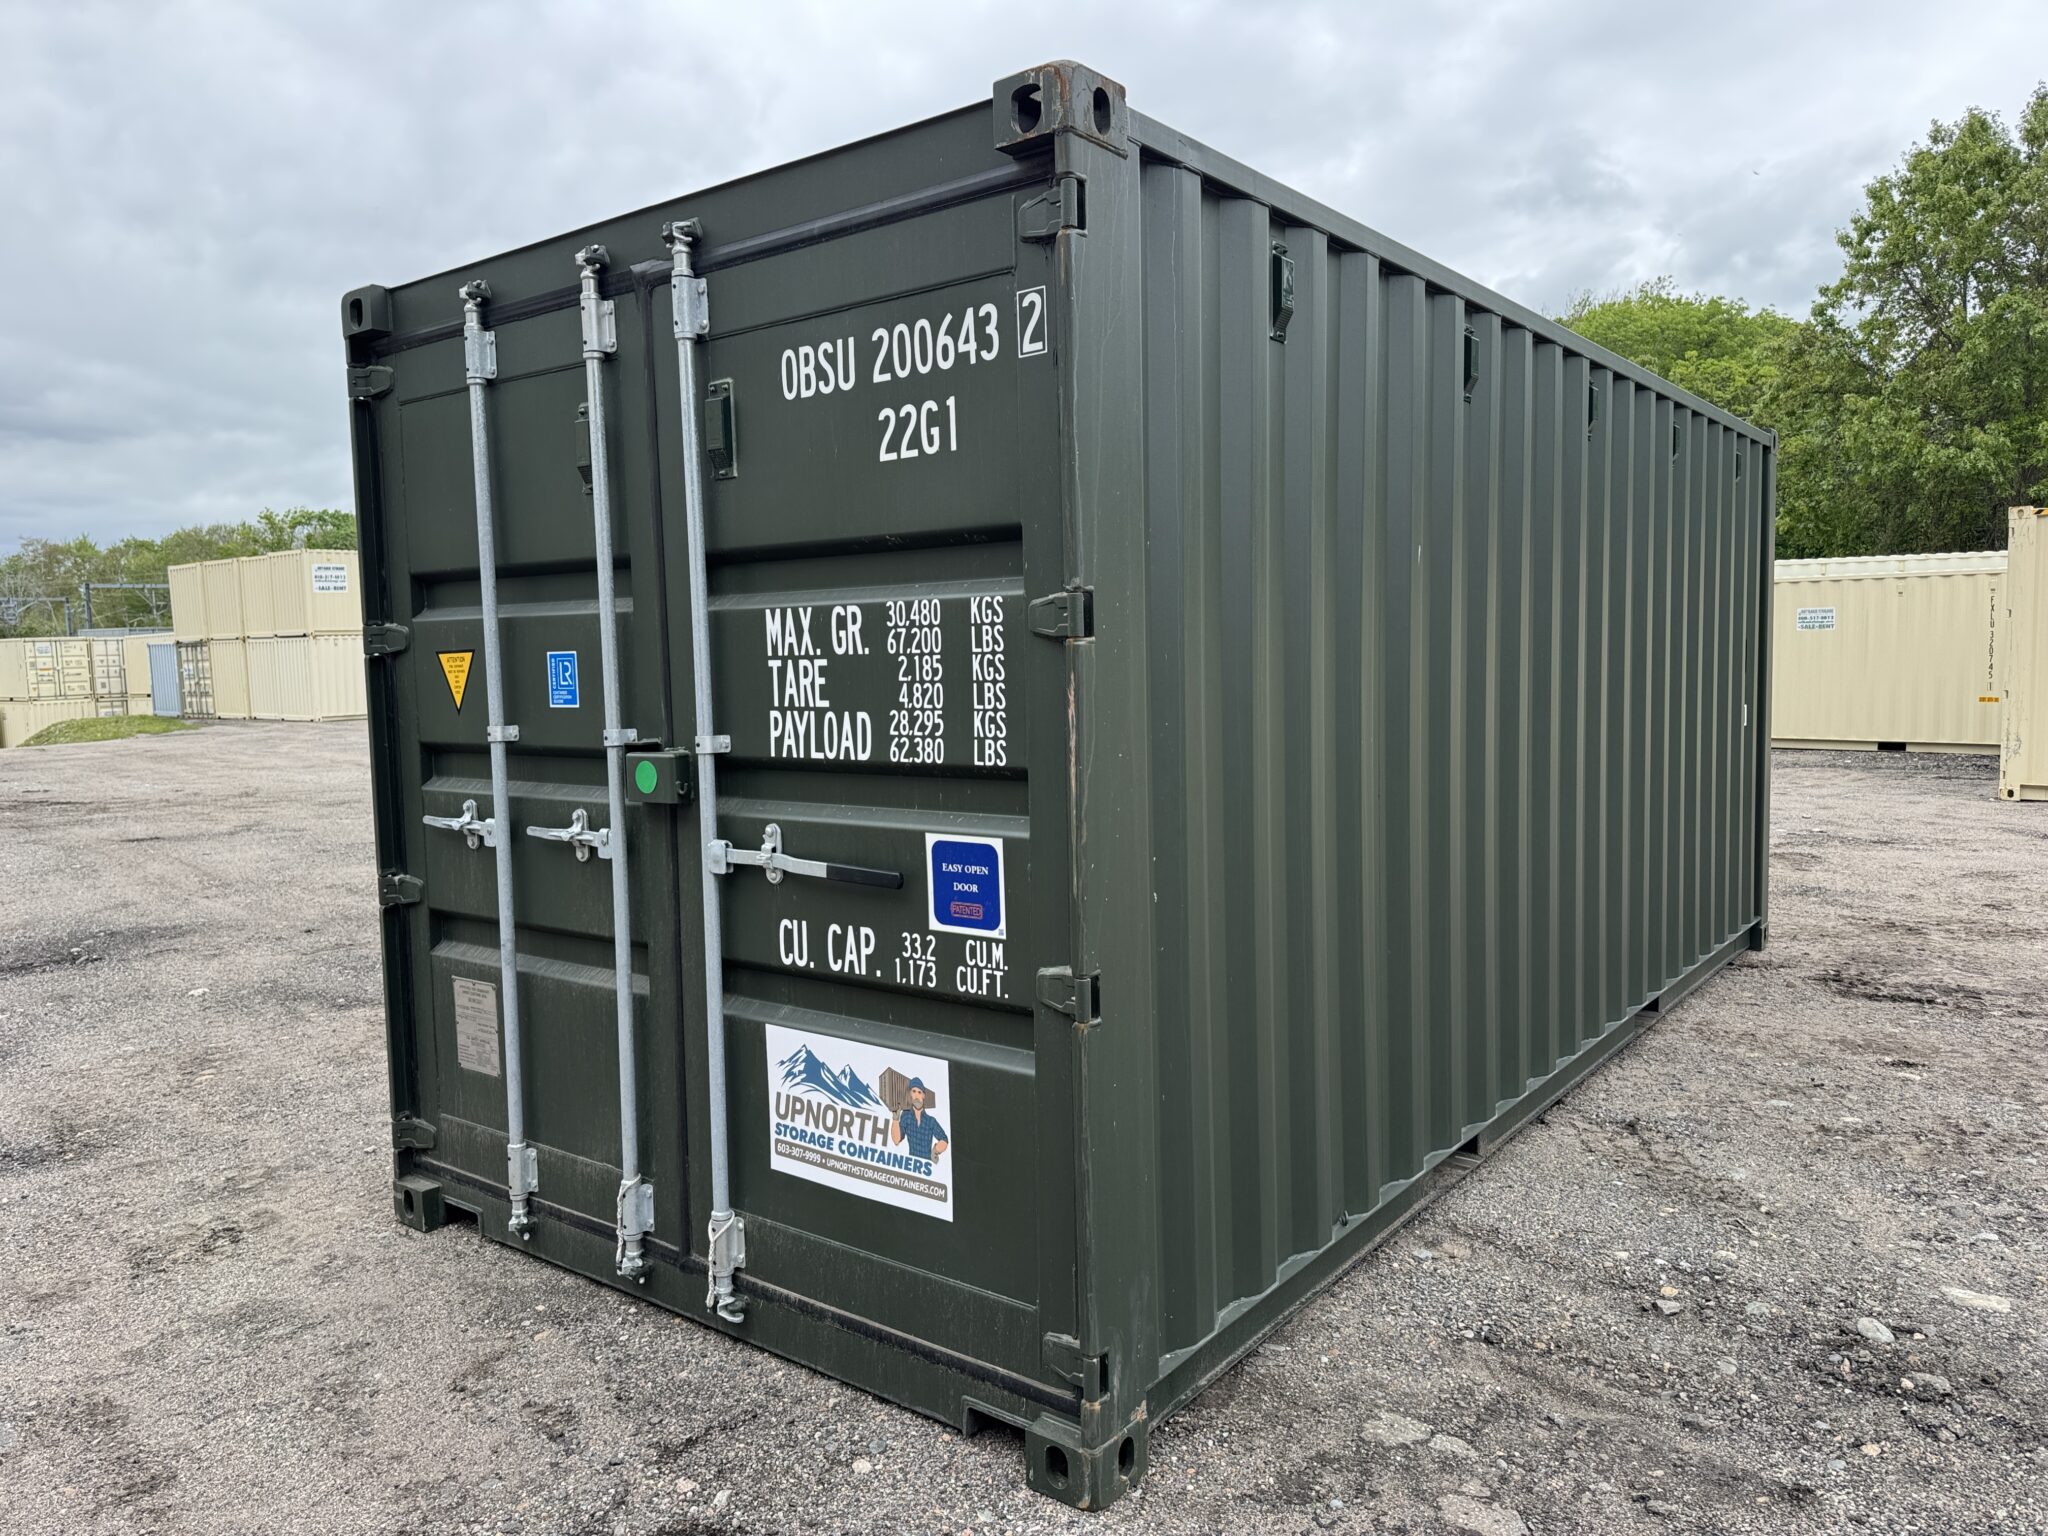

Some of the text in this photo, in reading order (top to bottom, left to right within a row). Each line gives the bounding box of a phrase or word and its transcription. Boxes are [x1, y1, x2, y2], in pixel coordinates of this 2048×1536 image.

[781, 292, 1044, 400] OBSU 200643 2
[878, 395, 957, 462] 22G1
[765, 605, 869, 656] MAX. GR.
[886, 596, 1004, 627] 30,480 KGS
[887, 625, 1004, 655] 67,200 LBS
[560, 661, 573, 685] LR
[768, 659, 830, 707] TARE
[898, 653, 1005, 682] 2,185 KGS
[899, 682, 1006, 710] 4,820 LBS
[769, 710, 872, 761] PAYLOAD
[889, 710, 1007, 738] 28,295 KGS
[889, 737, 1007, 766] 62,380 LBS
[942, 862, 989, 875] EASY OPEN
[953, 882, 979, 893] DOOR
[951, 904, 982, 916] PATENTED
[779, 919, 881, 977] CU. CAP.
[901, 932, 1009, 970] 33.2 CU.M.
[894, 957, 1009, 999] 1,173 CU.FT.
[775, 1091, 890, 1147] UPNORTH
[774, 1122, 933, 1177] STORAGE CONTAINERS
[777, 1142, 946, 1198] 603-307-9999 UPNORTHSTORAGECONTAINERS.COM
